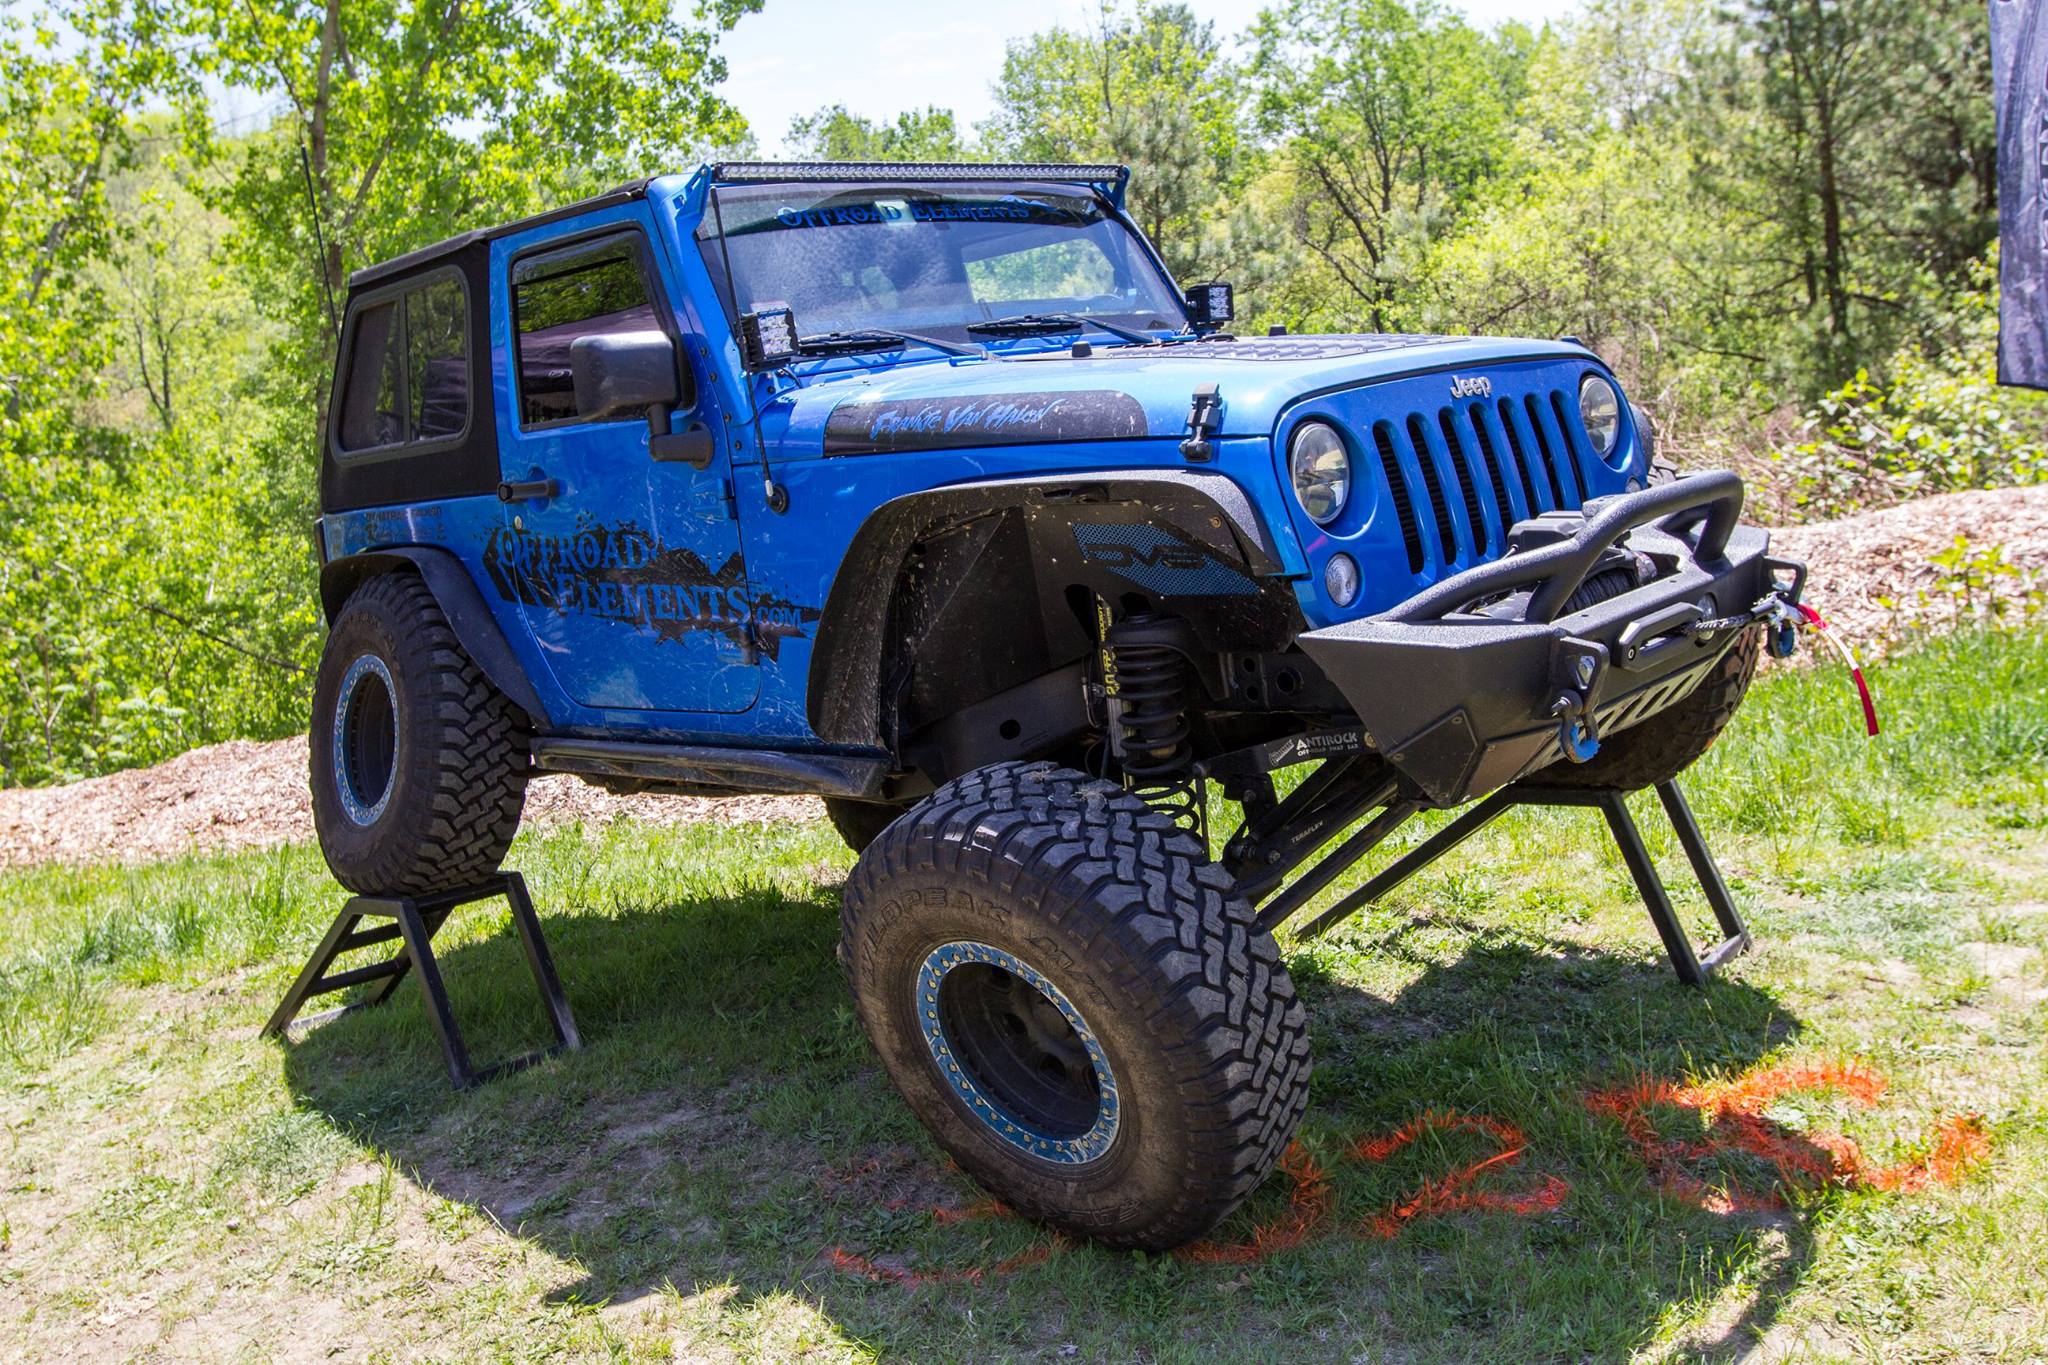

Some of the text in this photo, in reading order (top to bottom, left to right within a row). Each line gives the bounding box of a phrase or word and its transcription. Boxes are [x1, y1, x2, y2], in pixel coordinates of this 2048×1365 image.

[778, 200, 1030, 228] OFFROAD ELEMENTS
[1450, 374, 1492, 398] Jeep
[497, 526, 650, 577] OFFROAD
[1296, 732, 1358, 751] ANTIROCK
